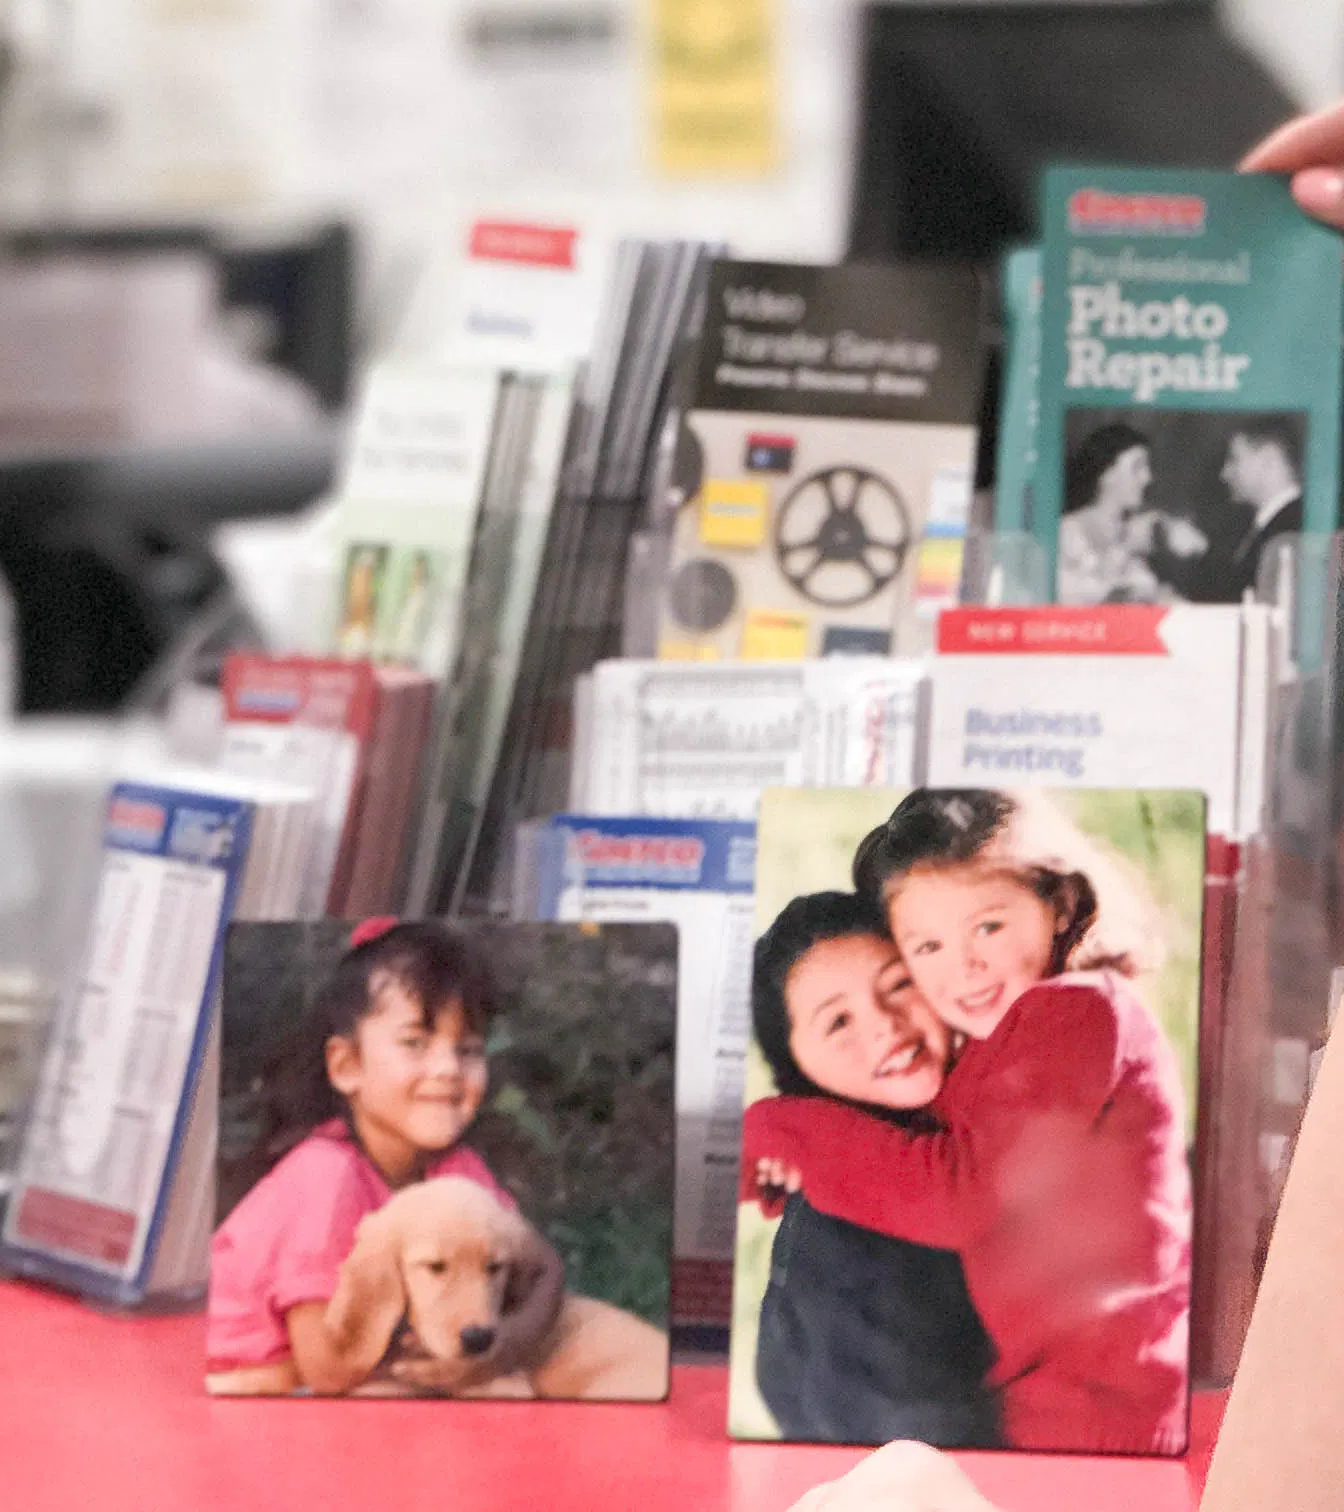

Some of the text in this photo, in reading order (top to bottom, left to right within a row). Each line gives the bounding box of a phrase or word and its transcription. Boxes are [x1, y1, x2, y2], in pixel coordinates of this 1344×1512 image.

[1067, 248, 1250, 284] Professional
[722, 289, 805, 324] Video
[1066, 284, 1228, 338] Photo
[722, 326, 940, 371] Transfer Service
[1066, 340, 1249, 401] Repair
[965, 707, 1102, 737] Business
[963, 743, 1084, 779] Printing
